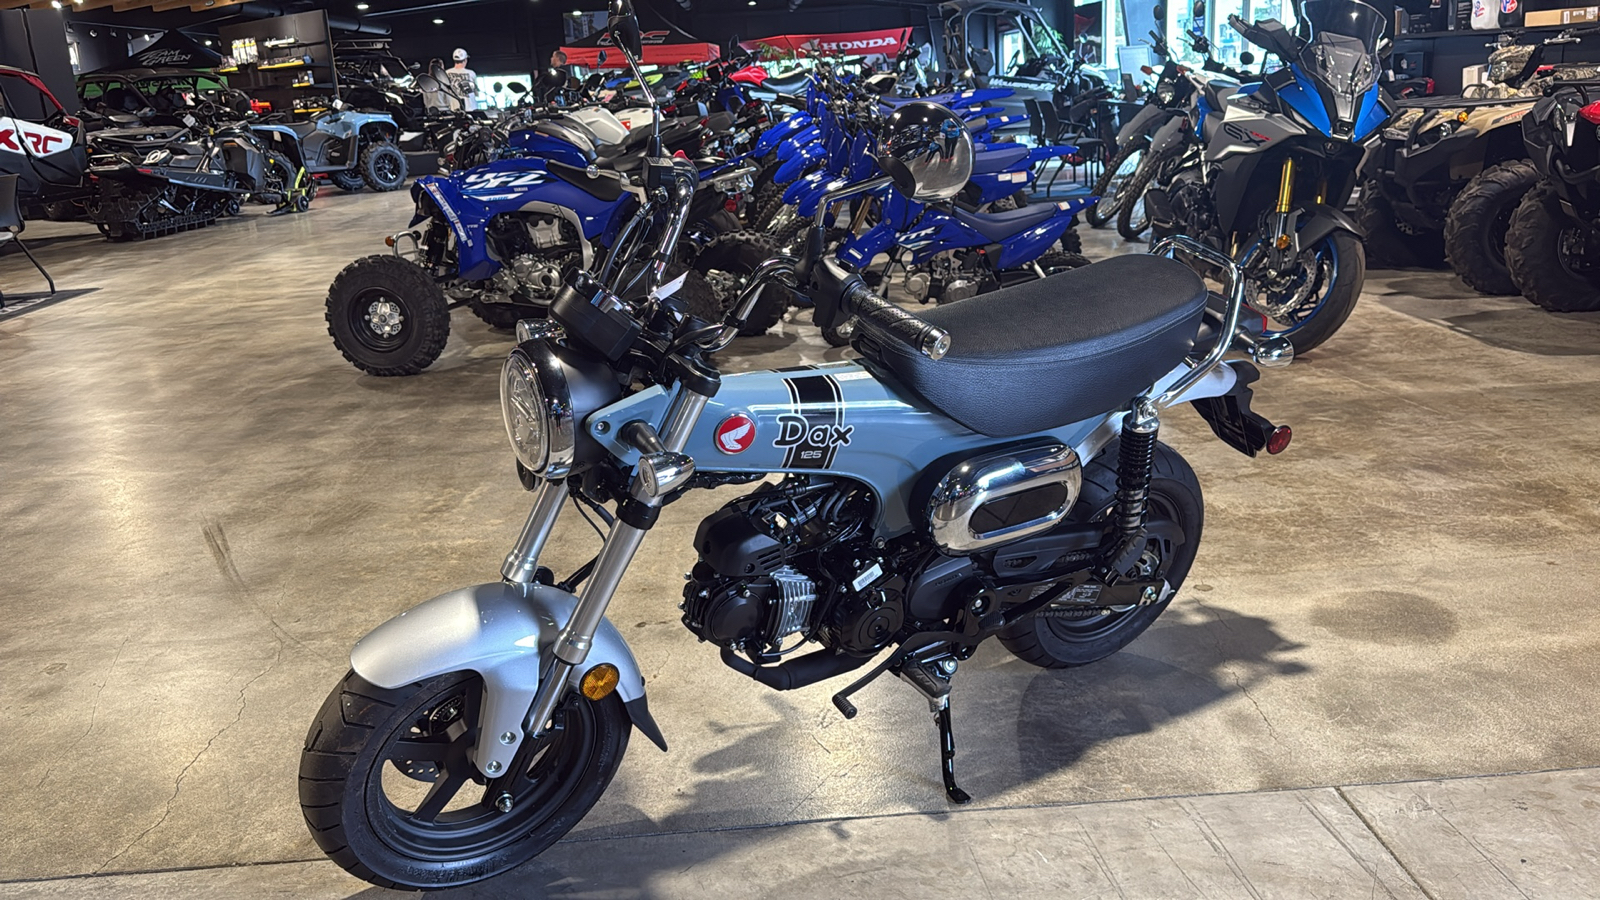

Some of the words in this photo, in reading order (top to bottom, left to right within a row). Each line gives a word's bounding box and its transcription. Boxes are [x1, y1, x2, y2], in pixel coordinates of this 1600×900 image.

[138, 48, 180, 61] TEAM
[142, 54, 192, 66] GREEN
[463, 170, 548, 190] YFZ
[772, 413, 854, 448] Dax
[800, 450, 823, 459] 125
